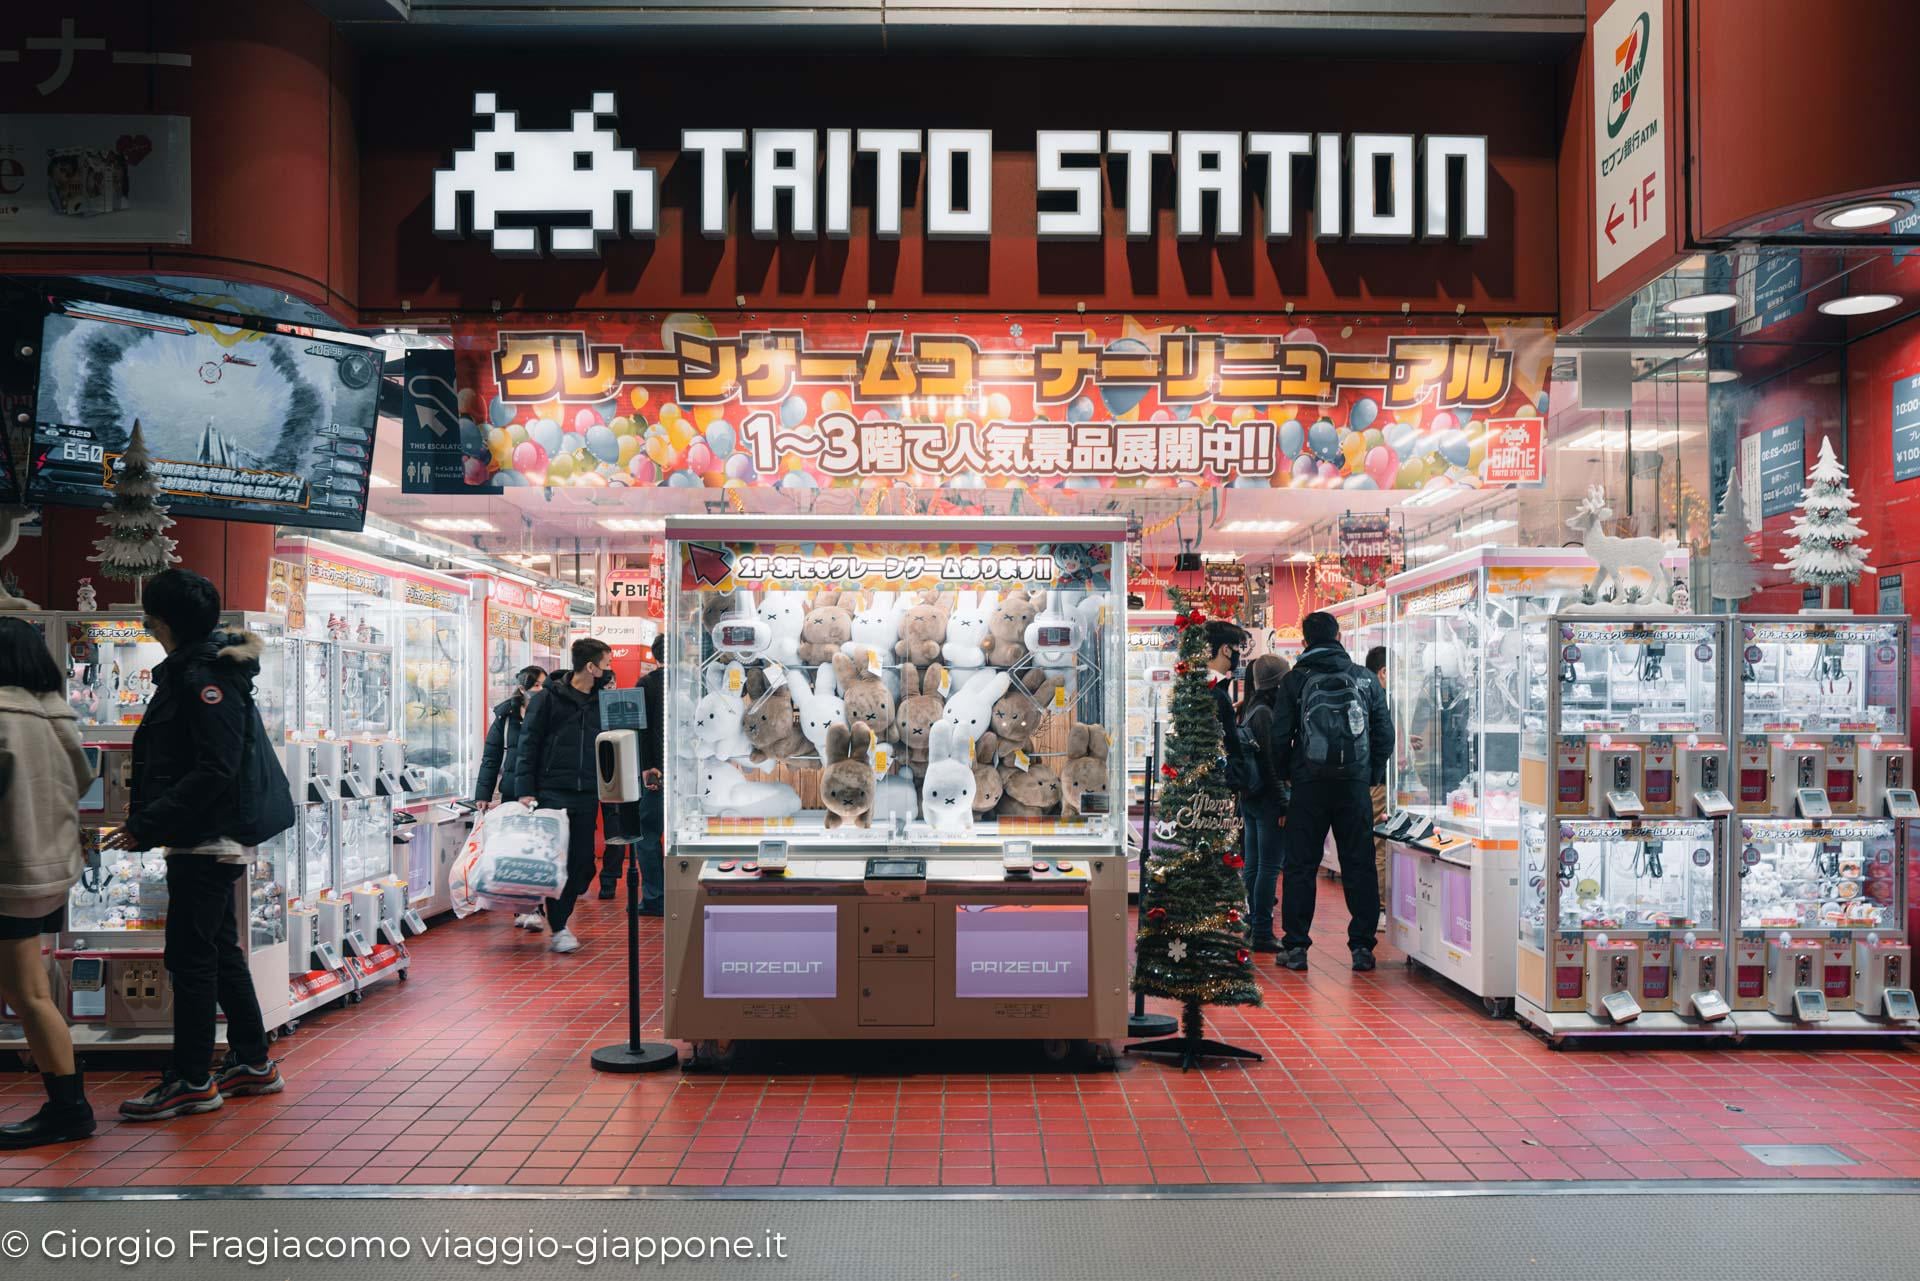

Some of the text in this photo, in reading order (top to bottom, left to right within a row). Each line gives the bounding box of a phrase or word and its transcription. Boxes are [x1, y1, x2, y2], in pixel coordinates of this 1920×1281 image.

[0, 17, 191, 97] ナー
[1612, 58, 1641, 104] BANK
[1601, 119, 1658, 178] セブン銀行ATM
[681, 128, 1489, 244] TAITO STATION
[1629, 171, 1656, 229] 1F
[492, 329, 1513, 408] クレーンゲームコーナーリニューアル
[64, 442, 104, 463] 650
[1491, 447, 1536, 468] GAME
[1177, 806, 1244, 830] Christmas
[1187, 788, 1236, 816] Merry
